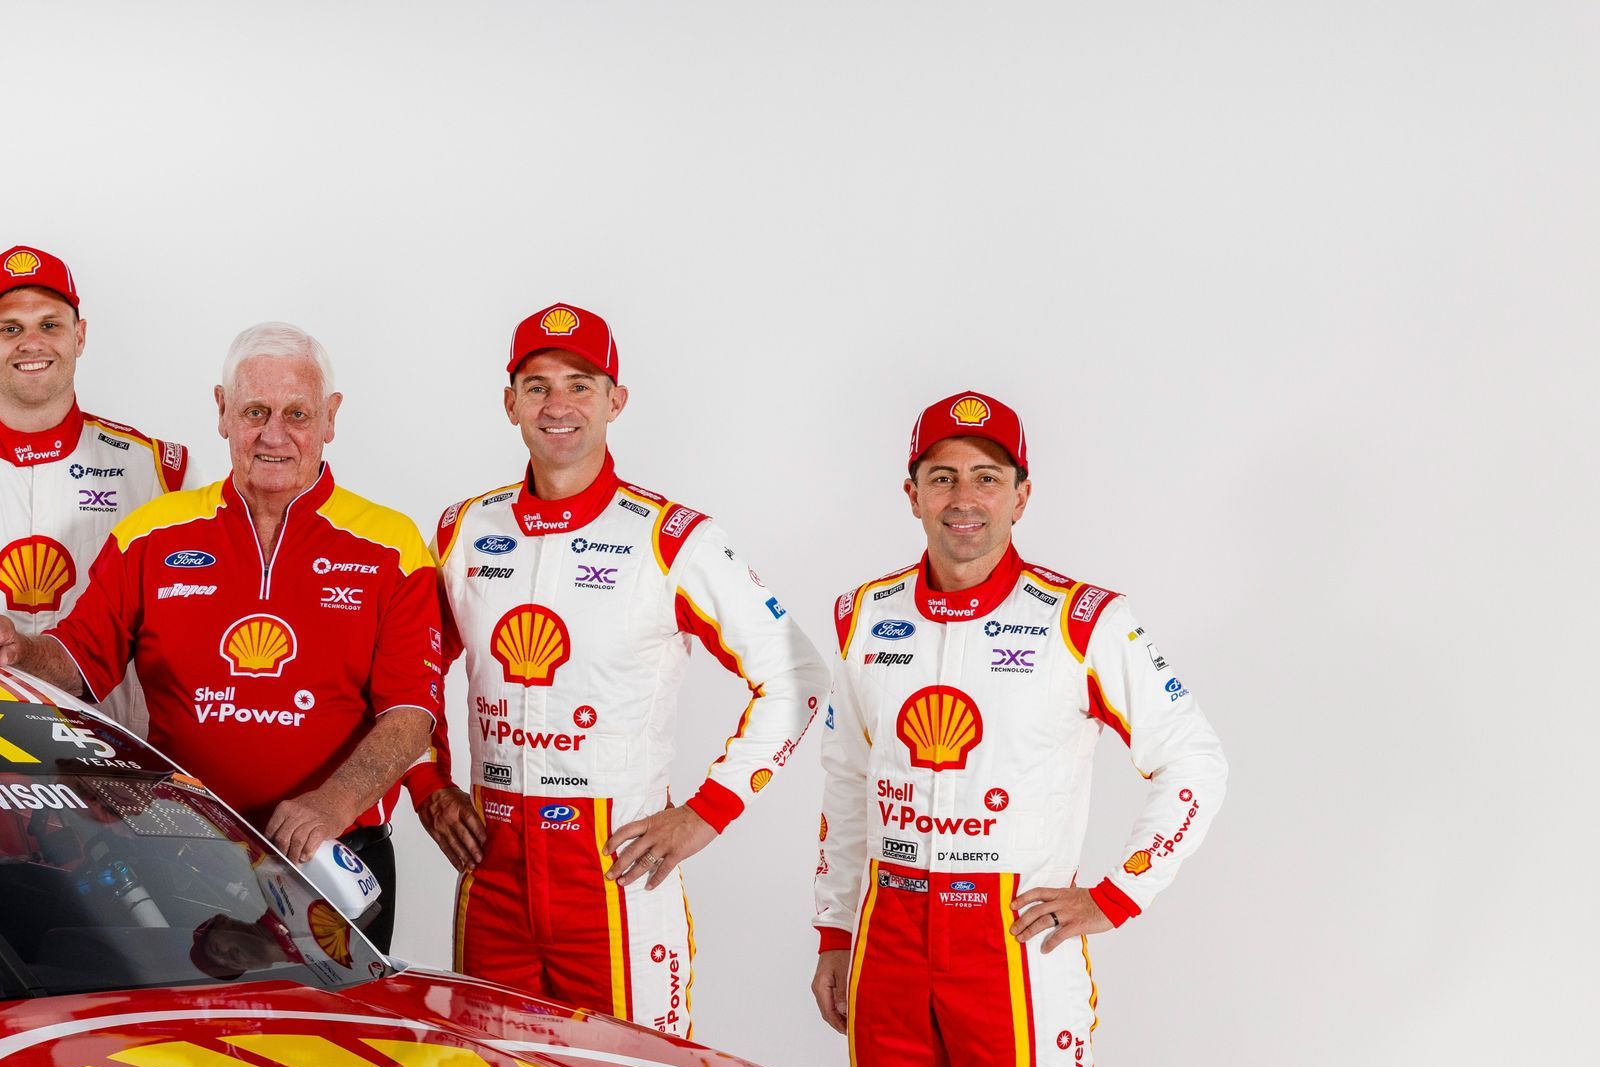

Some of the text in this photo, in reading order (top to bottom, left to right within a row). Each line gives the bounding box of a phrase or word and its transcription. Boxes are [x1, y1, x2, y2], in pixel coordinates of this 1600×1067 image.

[14, 445, 32, 454] Shell
[17, 450, 61, 463] V-Power
[85, 467, 125, 478] PIRTEK
[79, 490, 118, 507] DXC
[523, 513, 541, 522] Shell
[525, 519, 569, 531] V-Power
[589, 543, 634, 555] PIRTEK
[331, 563, 380, 574] PIRTEK
[478, 565, 514, 579] Repco
[576, 565, 619, 584] DXC
[169, 582, 218, 599] Repco
[574, 582, 616, 590] TECHNOLOGY
[320, 587, 364, 604] DXC
[320, 602, 362, 611] TECHNOLOGY
[927, 599, 946, 607] Shell
[929, 605, 976, 617] V-Power
[1002, 624, 1049, 636] PIRTEK
[874, 652, 914, 666] Repco
[991, 648, 1036, 667] DXC
[991, 666, 1034, 674] TECHNOLOGY
[195, 686, 235, 702] Shell
[476, 697, 508, 718] Shell
[196, 703, 305, 727] V-Power
[52, 722, 116, 759] 45
[479, 717, 587, 752] V-Power
[773, 739, 793, 763] Shell
[76, 757, 142, 770] YEARS
[485, 765, 510, 777] rpm
[541, 777, 588, 786] DAVISON
[877, 779, 913, 803] Shell
[878, 801, 997, 836] V-Power
[541, 821, 581, 831] Doric
[885, 840, 915, 853] rpm
[1145, 833, 1165, 855] hell
[938, 852, 999, 861] D'ALBERTO
[358, 873, 378, 896] Dori
[890, 875, 927, 889] PROBACK
[939, 892, 988, 904] WESTERN
[667, 950, 680, 1037] -Power
[654, 1015, 666, 1033] ell
